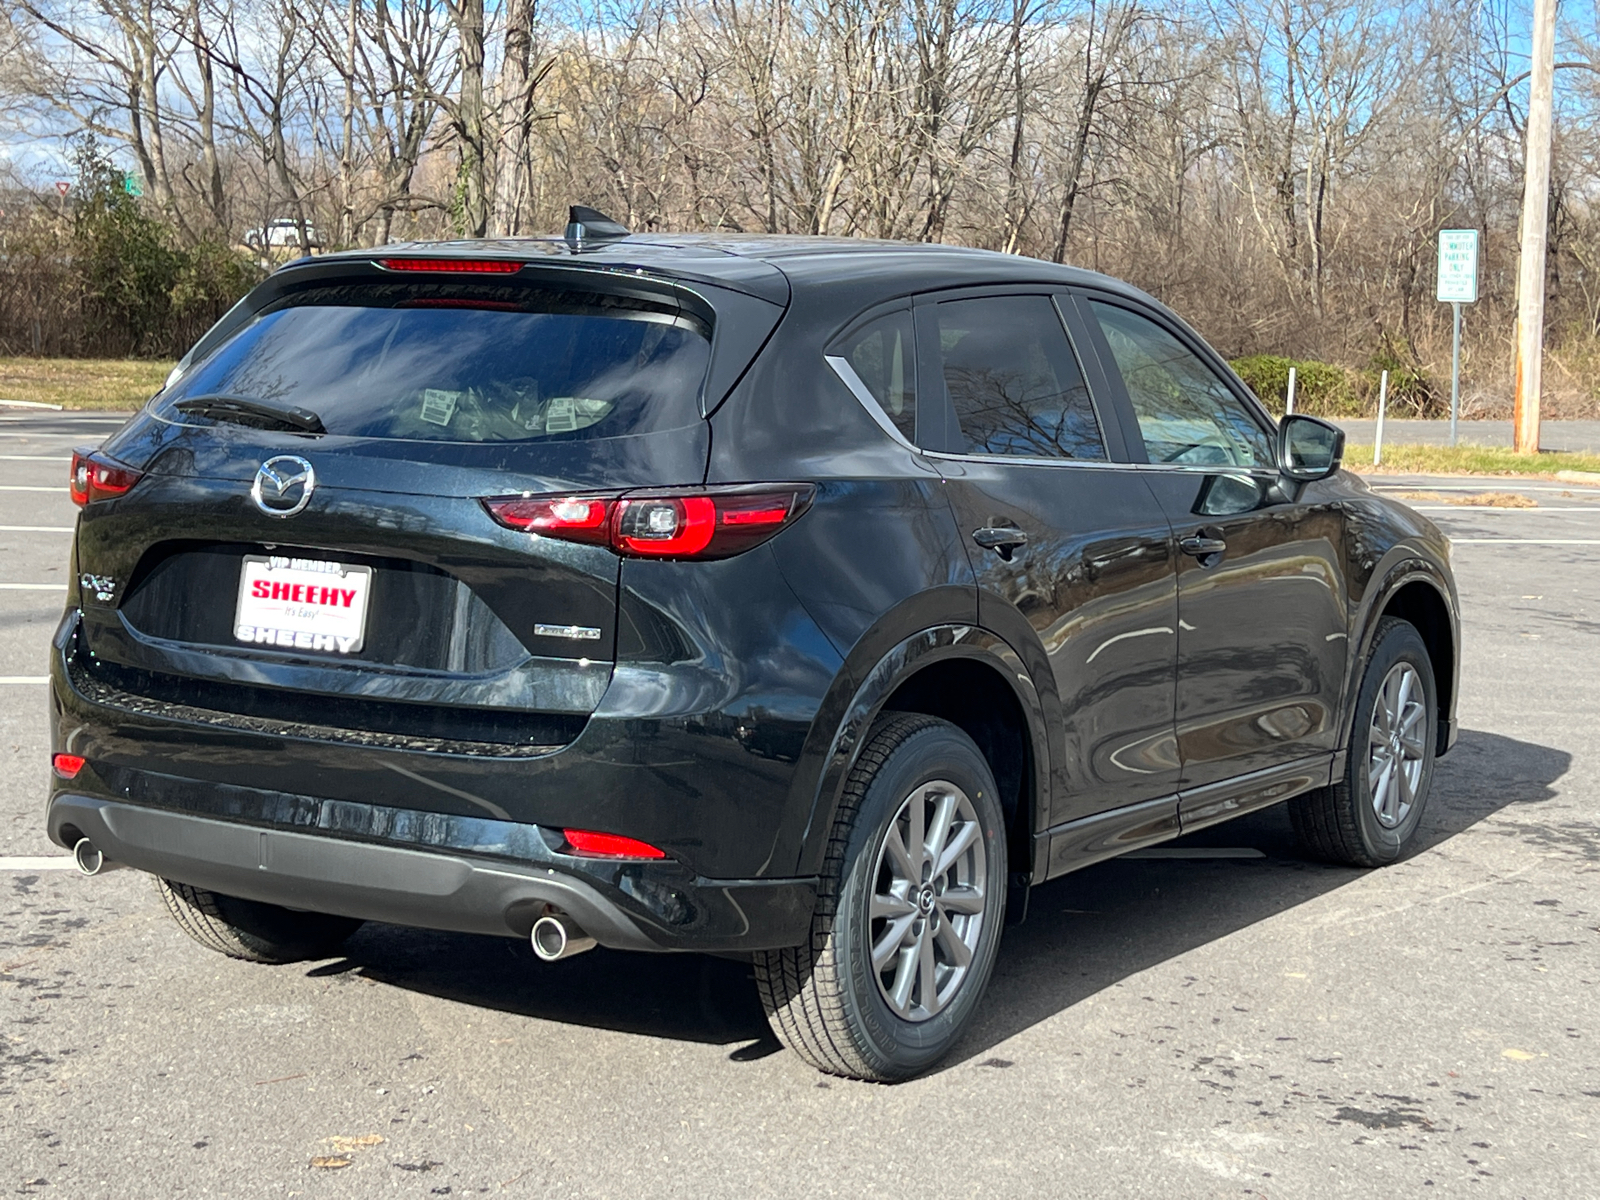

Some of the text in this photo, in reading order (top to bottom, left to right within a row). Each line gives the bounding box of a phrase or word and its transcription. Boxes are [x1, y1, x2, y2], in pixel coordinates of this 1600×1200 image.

[1444, 252, 1470, 261] PARKING
[269, 556, 341, 574] VIP MEMBER
[251, 579, 357, 608] SHEEHY
[284, 606, 296, 616] It's
[237, 625, 359, 653] SHEEHY
